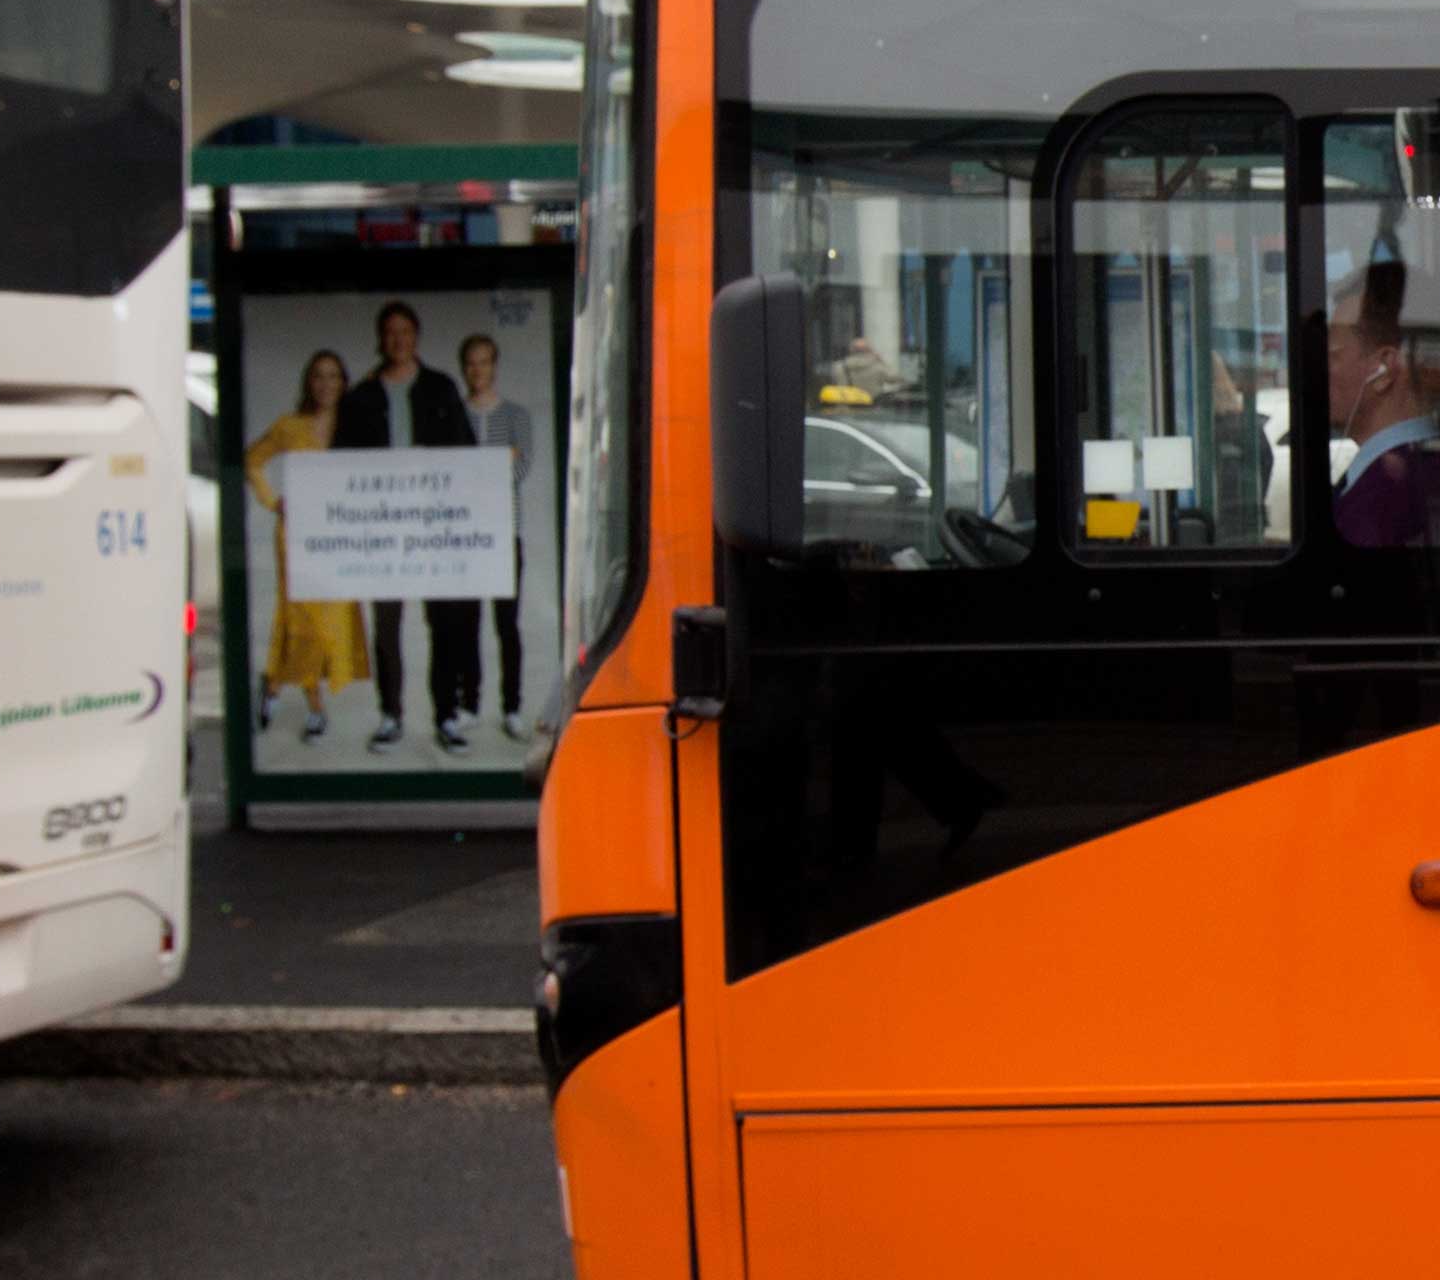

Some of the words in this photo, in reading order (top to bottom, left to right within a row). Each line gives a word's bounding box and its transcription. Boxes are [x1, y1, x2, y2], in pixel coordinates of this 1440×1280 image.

[97, 511, 147, 557] 614
[304, 532, 397, 557] aamujen
[402, 527, 495, 556] puolesta
